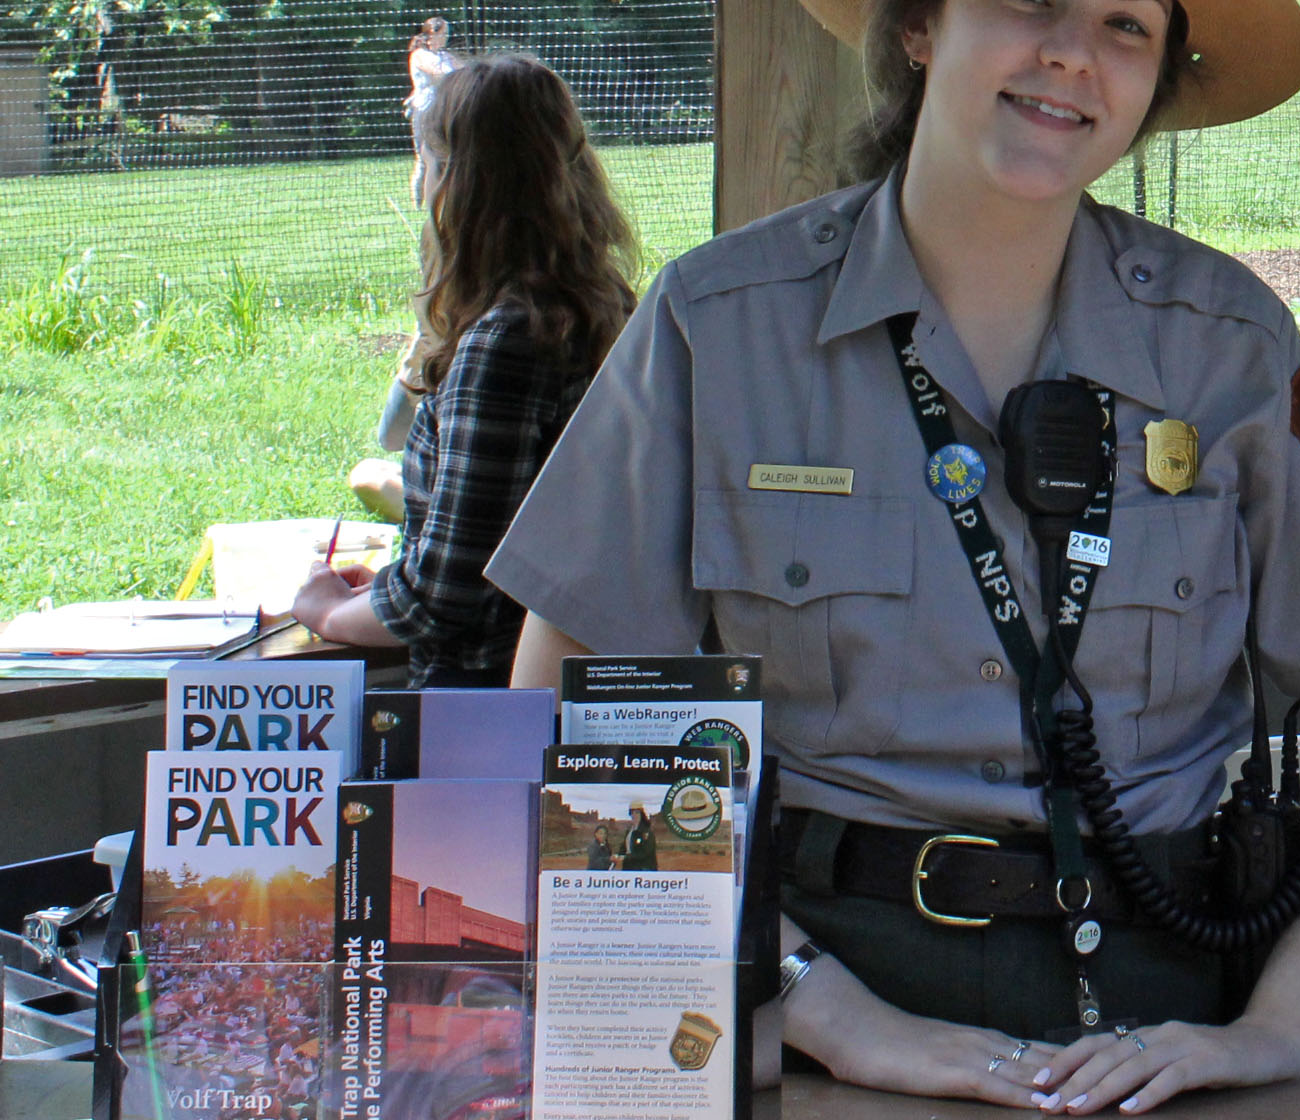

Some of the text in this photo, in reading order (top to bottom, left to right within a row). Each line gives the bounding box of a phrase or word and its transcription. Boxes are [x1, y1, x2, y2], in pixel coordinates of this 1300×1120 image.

[760, 472, 846, 486] CALEIGH SULLIVAN
[929, 455, 943, 486] WOLF
[948, 477, 982, 499] LIVES
[1049, 480, 1086, 488] MOTOROLA
[975, 550, 1020, 622] NPS
[183, 684, 335, 710] FIND YOUR
[585, 709, 599, 720] Be
[614, 708, 696, 722] WebRanger!
[182, 714, 336, 750] PARK
[684, 721, 744, 742] WEB RANGERS
[557, 754, 721, 772] Explore, Learn, Protect
[168, 767, 325, 793] FIND YOUR
[166, 797, 324, 846] PARK
[553, 876, 689, 893] Be a Junior Ranger!
[366, 939, 386, 982] Arts
[341, 935, 362, 1120] Trap National Park
[363, 986, 388, 1099] Performing
[217, 1088, 273, 1115] Trap
